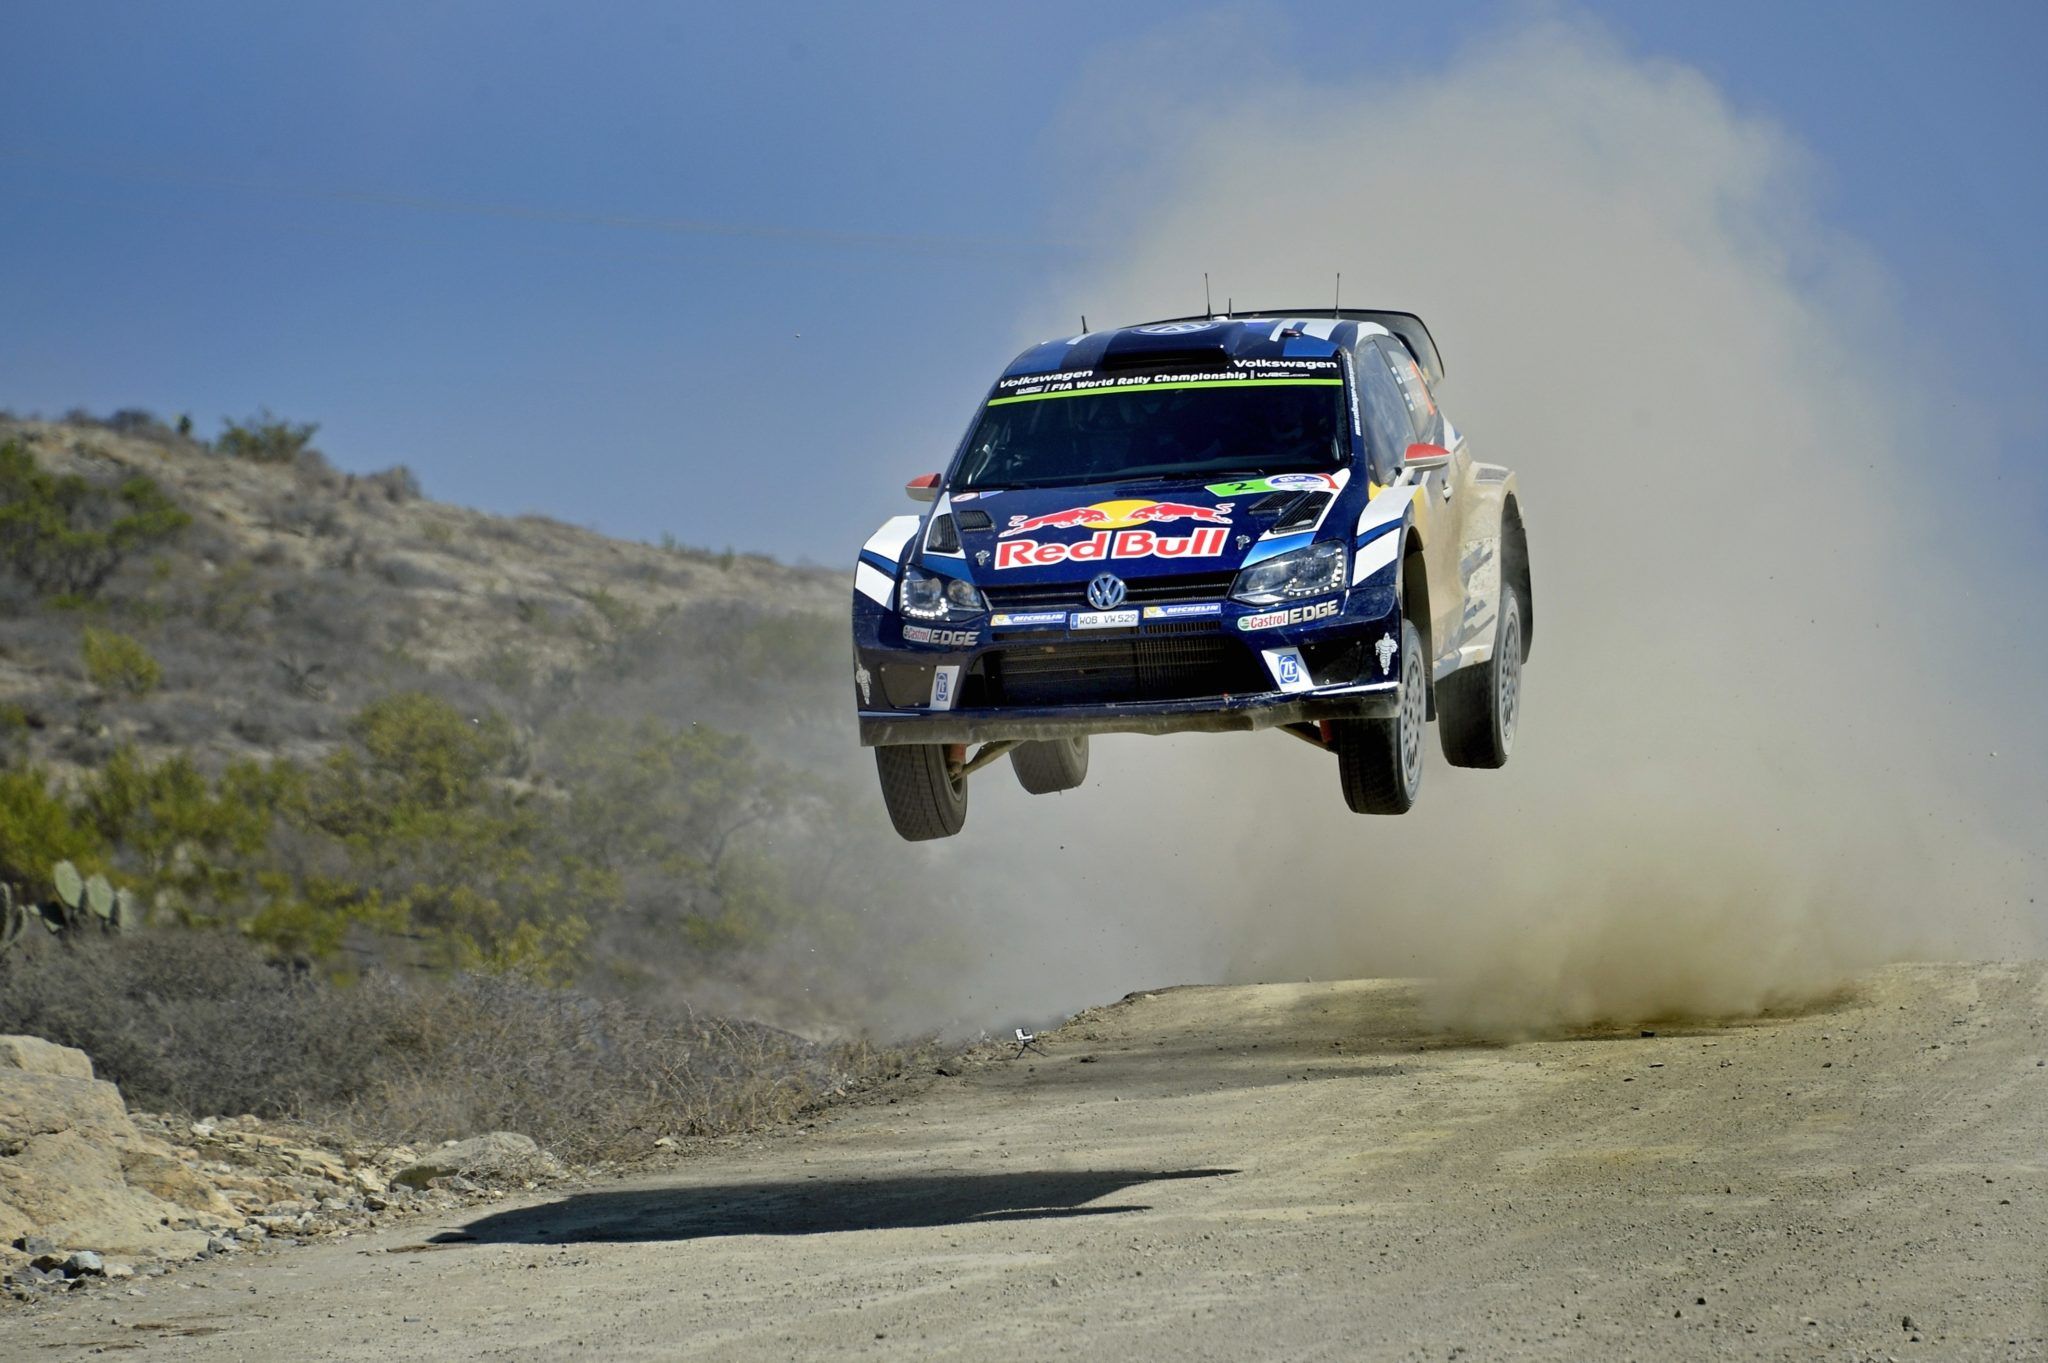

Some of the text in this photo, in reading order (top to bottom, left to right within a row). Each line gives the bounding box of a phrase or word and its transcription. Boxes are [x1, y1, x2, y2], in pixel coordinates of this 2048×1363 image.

[1233, 359, 1338, 369] Volkswagen
[1000, 370, 1093, 388] Volkswagen
[1051, 383, 1072, 391] FIA
[1076, 378, 1114, 388] World
[1117, 376, 1151, 385] Rally
[1154, 371, 1247, 382] Championship
[1228, 482, 1254, 491] 2
[996, 529, 1229, 568] Red Bull
[1167, 605, 1219, 614] MICHELIN
[1250, 599, 1338, 629] Castrol EDGE
[1013, 614, 1064, 623] MICHELIN
[1080, 614, 1136, 625] WOB VW 529
[930, 629, 981, 646] EDGE
[1281, 660, 1298, 678] ZF
